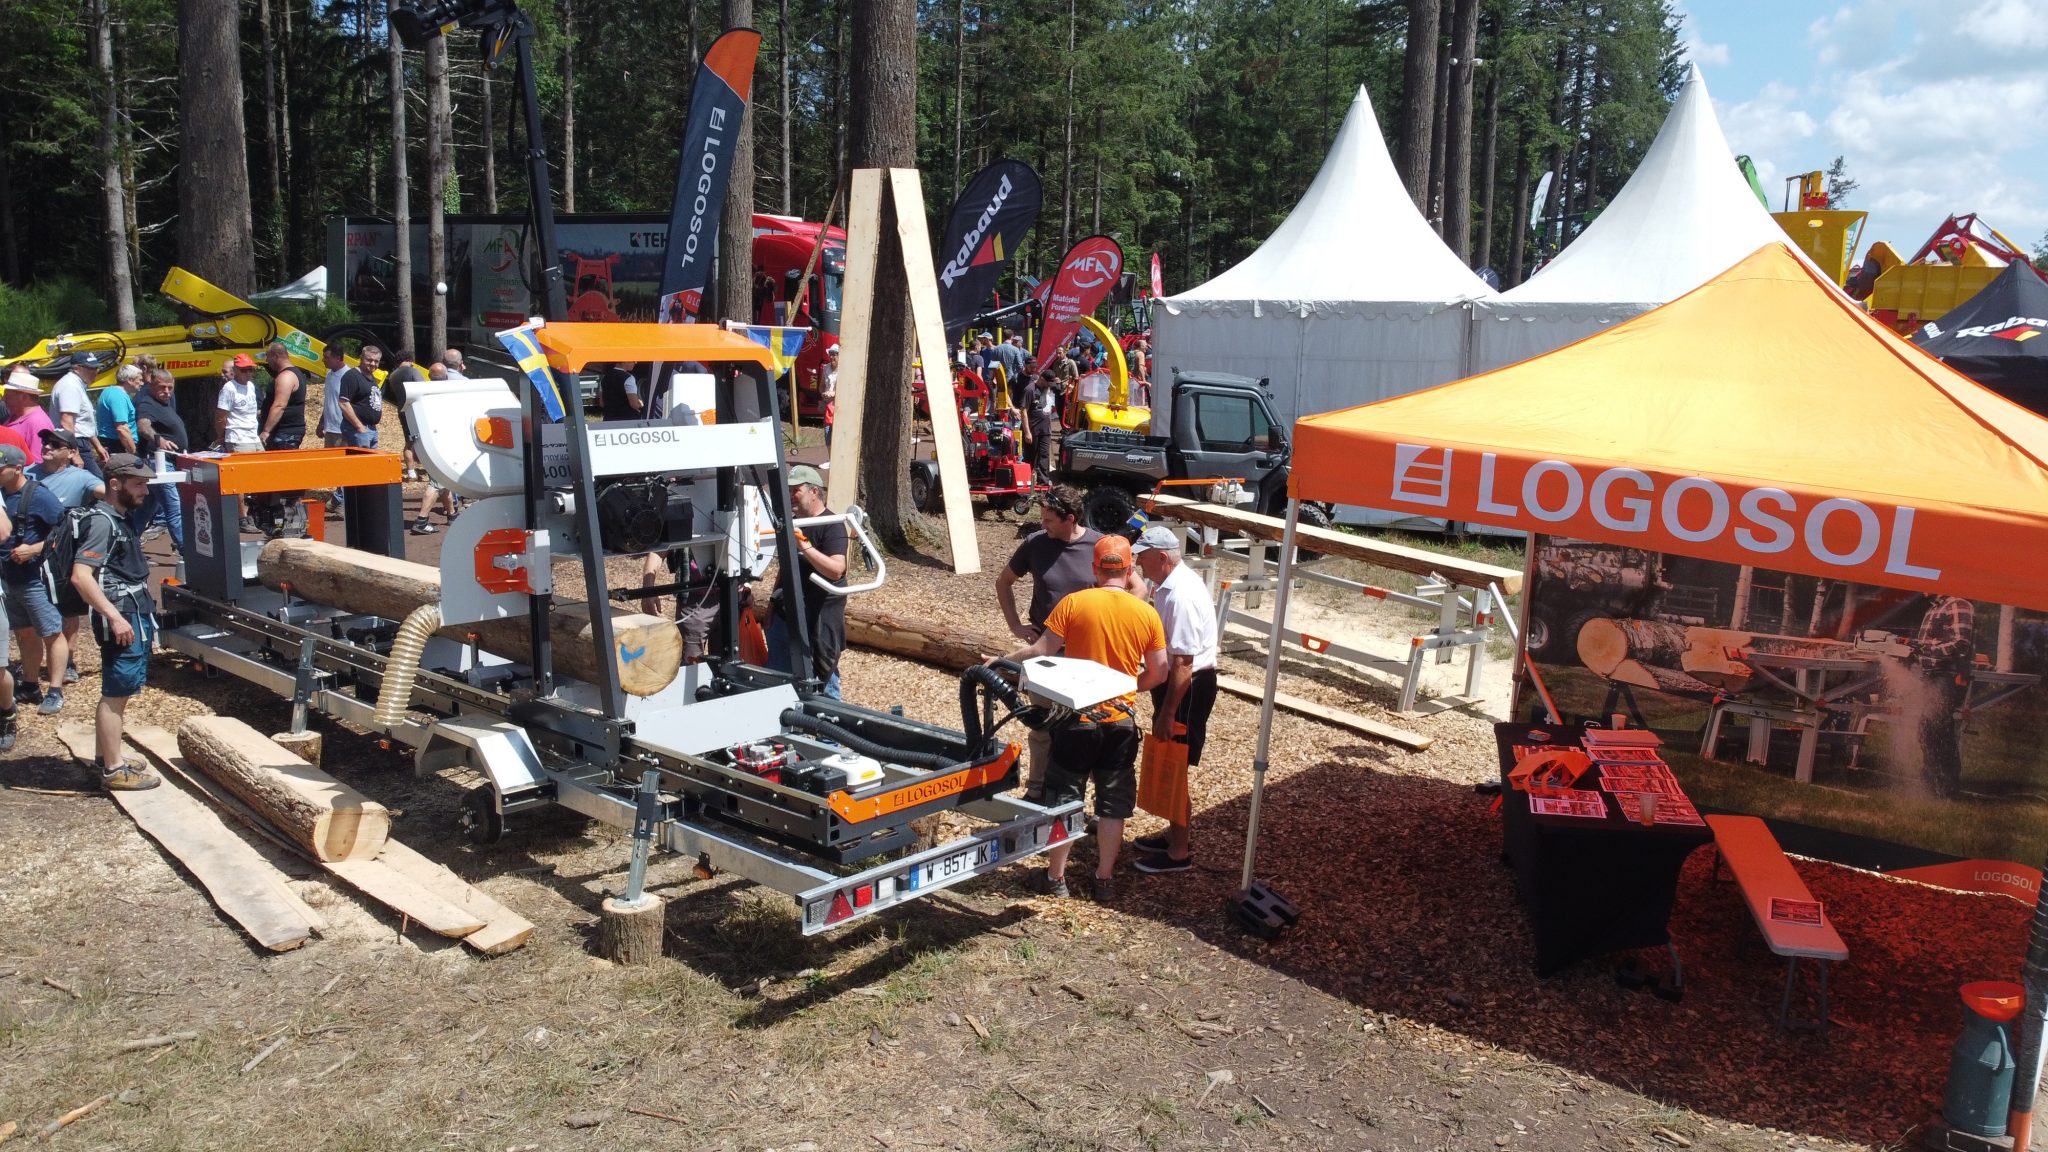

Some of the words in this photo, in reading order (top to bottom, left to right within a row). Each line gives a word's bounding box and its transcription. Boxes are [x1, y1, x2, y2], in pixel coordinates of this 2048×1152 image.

[681, 136, 721, 268] LOGOSOL
[940, 173, 1013, 289] Rabaud
[1066, 256, 1113, 280] MFA
[1955, 316, 2048, 339] Raba
[167, 359, 212, 370] Master
[610, 430, 680, 446] LOGOSOL
[1476, 452, 1942, 581] LOGOSOL
[907, 775, 966, 803] LOGOSOL
